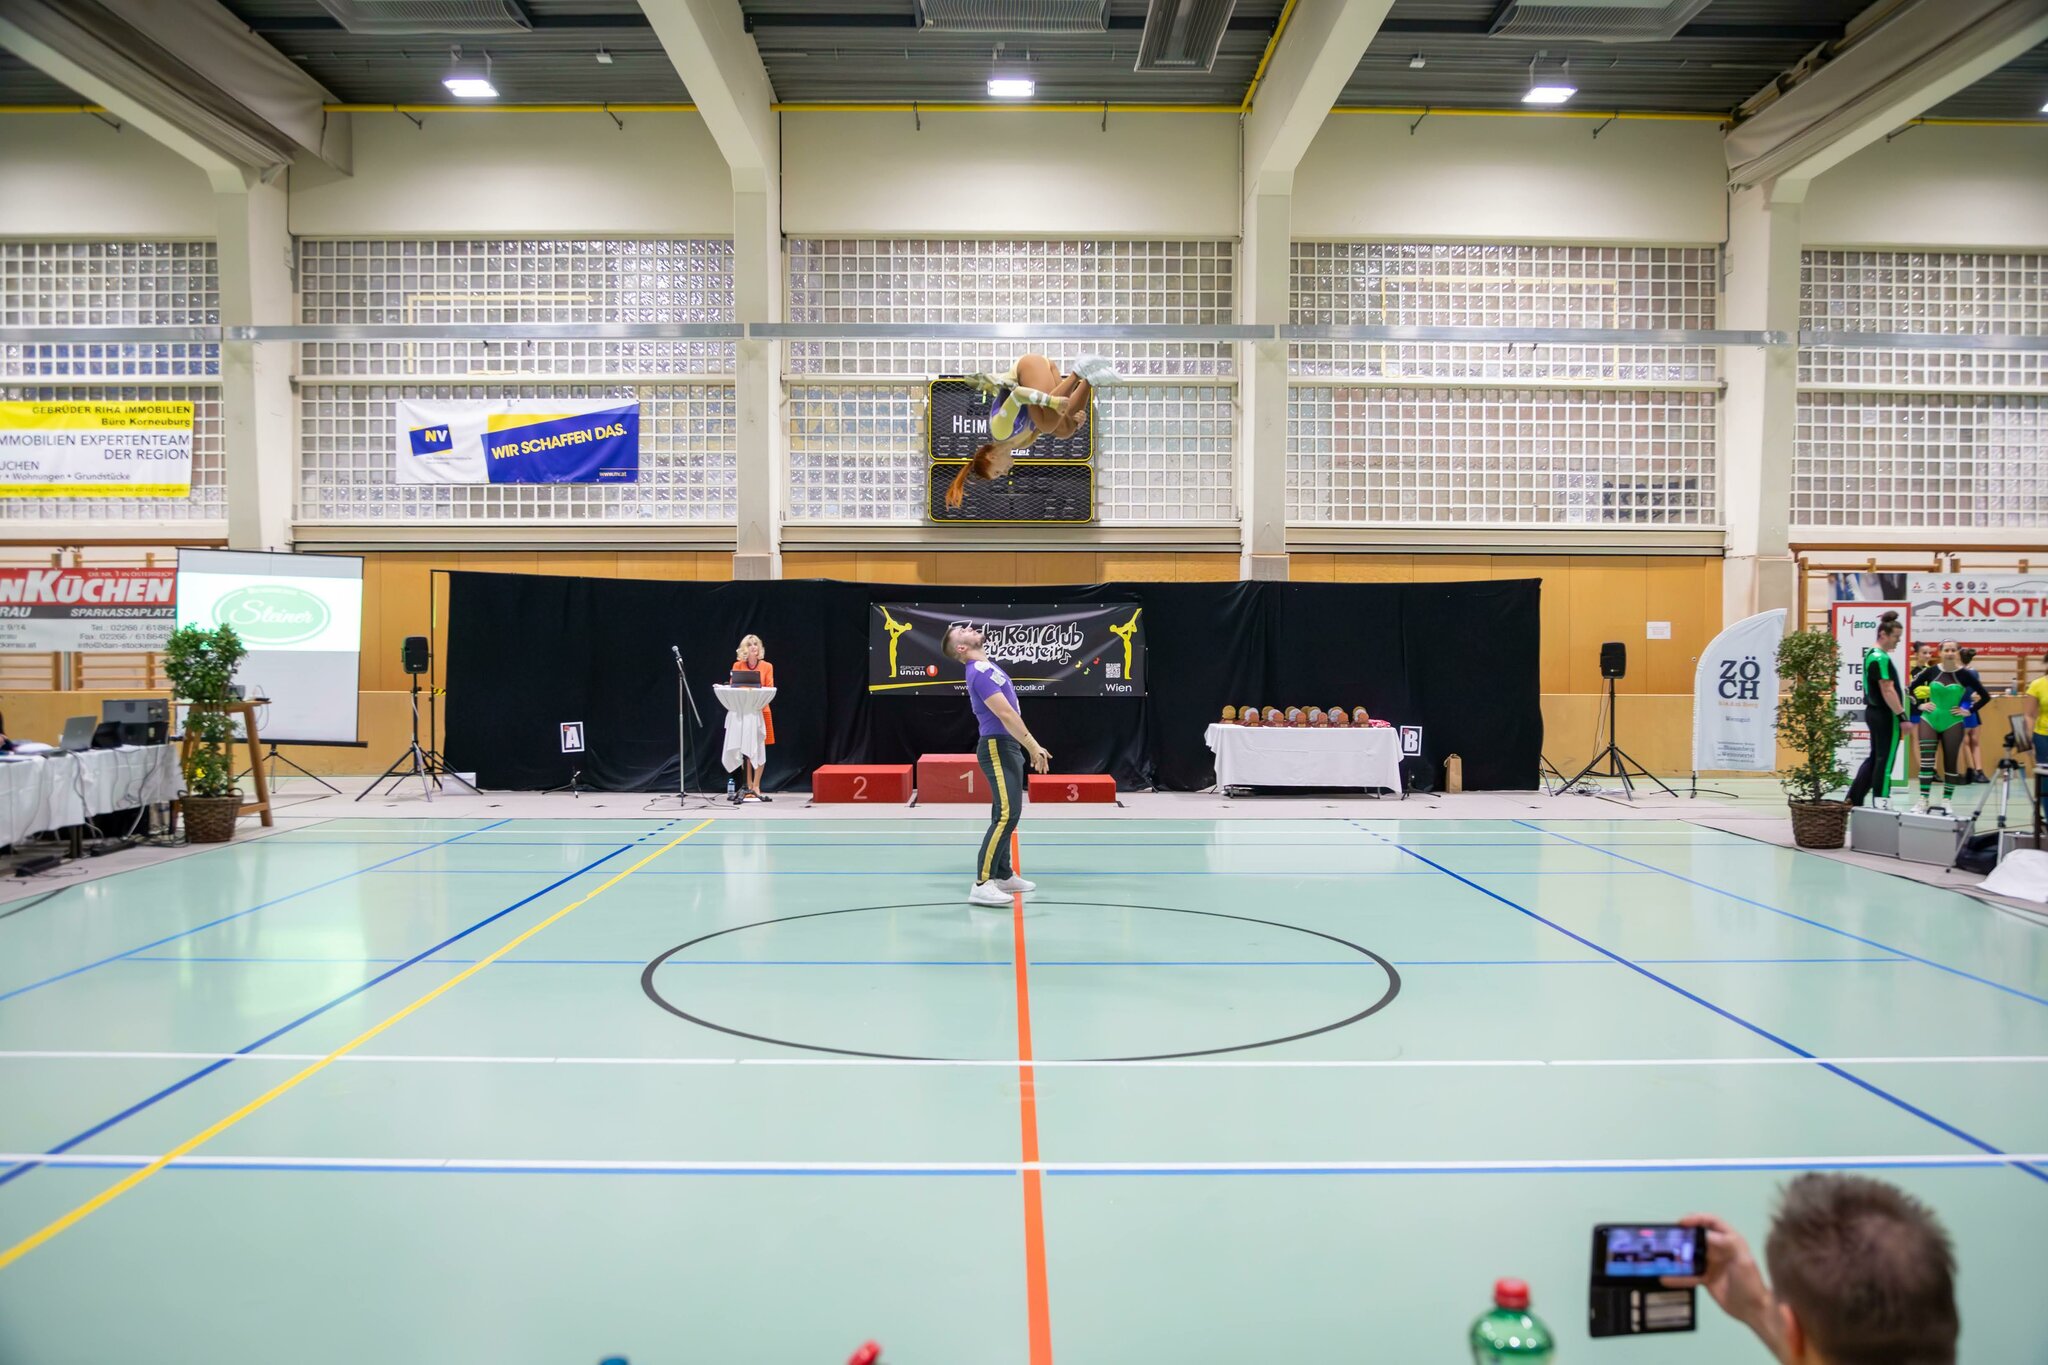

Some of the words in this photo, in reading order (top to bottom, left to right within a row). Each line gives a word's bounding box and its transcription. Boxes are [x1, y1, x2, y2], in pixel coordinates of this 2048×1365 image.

[32, 405, 91, 414] GEBRÜDER
[95, 406, 121, 414] RIHA
[125, 406, 190, 414] IMMOBILIEN
[130, 418, 190, 428] Korneuburg
[953, 415, 987, 434] HEIM
[81, 435, 190, 446] EXPERTENTEAM
[425, 430, 448, 442] NV
[491, 444, 520, 460] WIR
[521, 429, 592, 454] SCHAFFEN
[594, 423, 627, 440] DAS.
[104, 449, 131, 460] DER
[137, 449, 190, 460] REGION
[0, 570, 174, 604] NKÜCHEN
[71, 608, 176, 617] SPARKASSAPLATZ
[1843, 614, 1877, 637] Marco
[1003, 624, 1040, 645] Roll
[1041, 622, 1084, 650] Club
[1720, 656, 1760, 680] ZÖ
[1105, 683, 1132, 692] Wien
[1718, 680, 1760, 700] CH
[566, 726, 580, 748] A
[1404, 729, 1418, 751] B
[853, 776, 868, 799] 2
[959, 770, 973, 793] 1
[1066, 783, 1079, 801] 3
